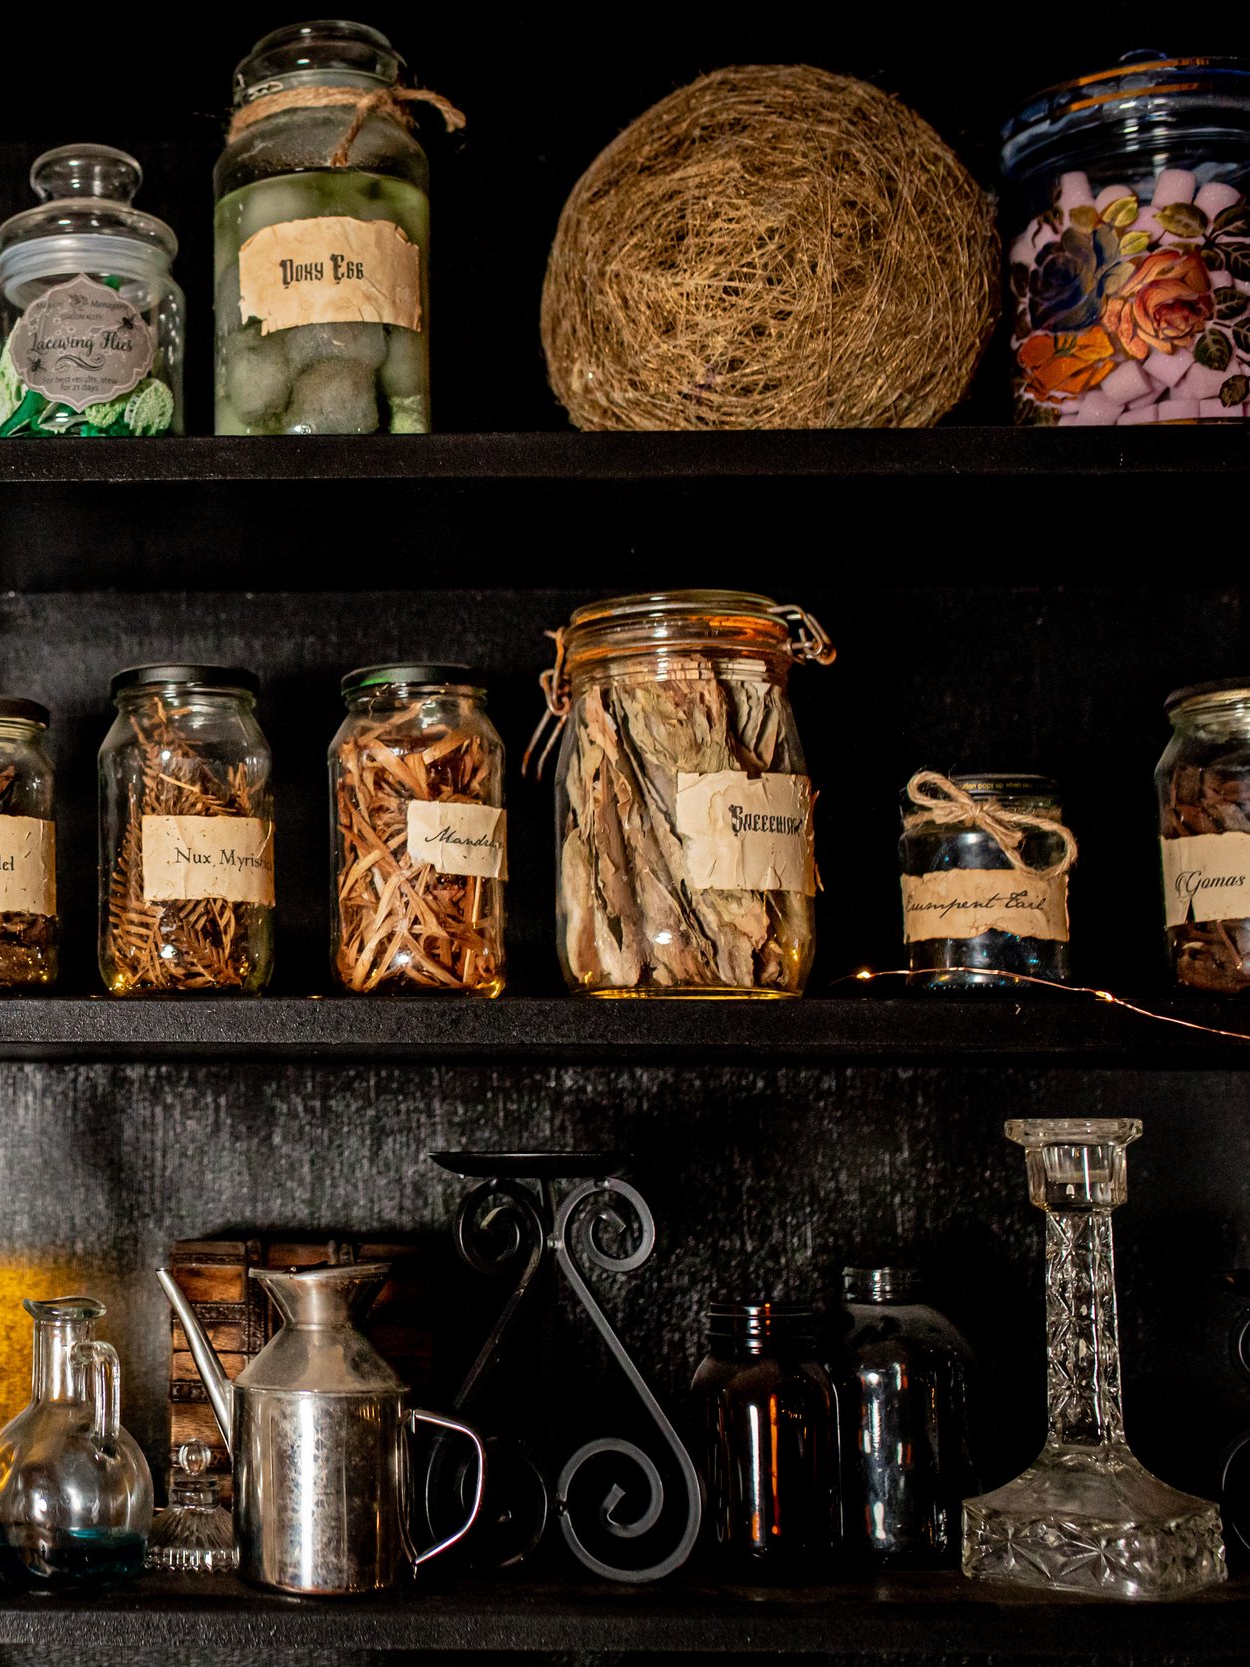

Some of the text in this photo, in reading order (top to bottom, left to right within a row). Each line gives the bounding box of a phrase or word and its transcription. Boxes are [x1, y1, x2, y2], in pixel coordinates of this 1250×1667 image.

[27, 330, 135, 356] Lacewing Flies
[55, 376, 71, 384] best
[60, 383, 71, 392] for
[81, 383, 99, 393] days
[174, 846, 212, 865] Nux
